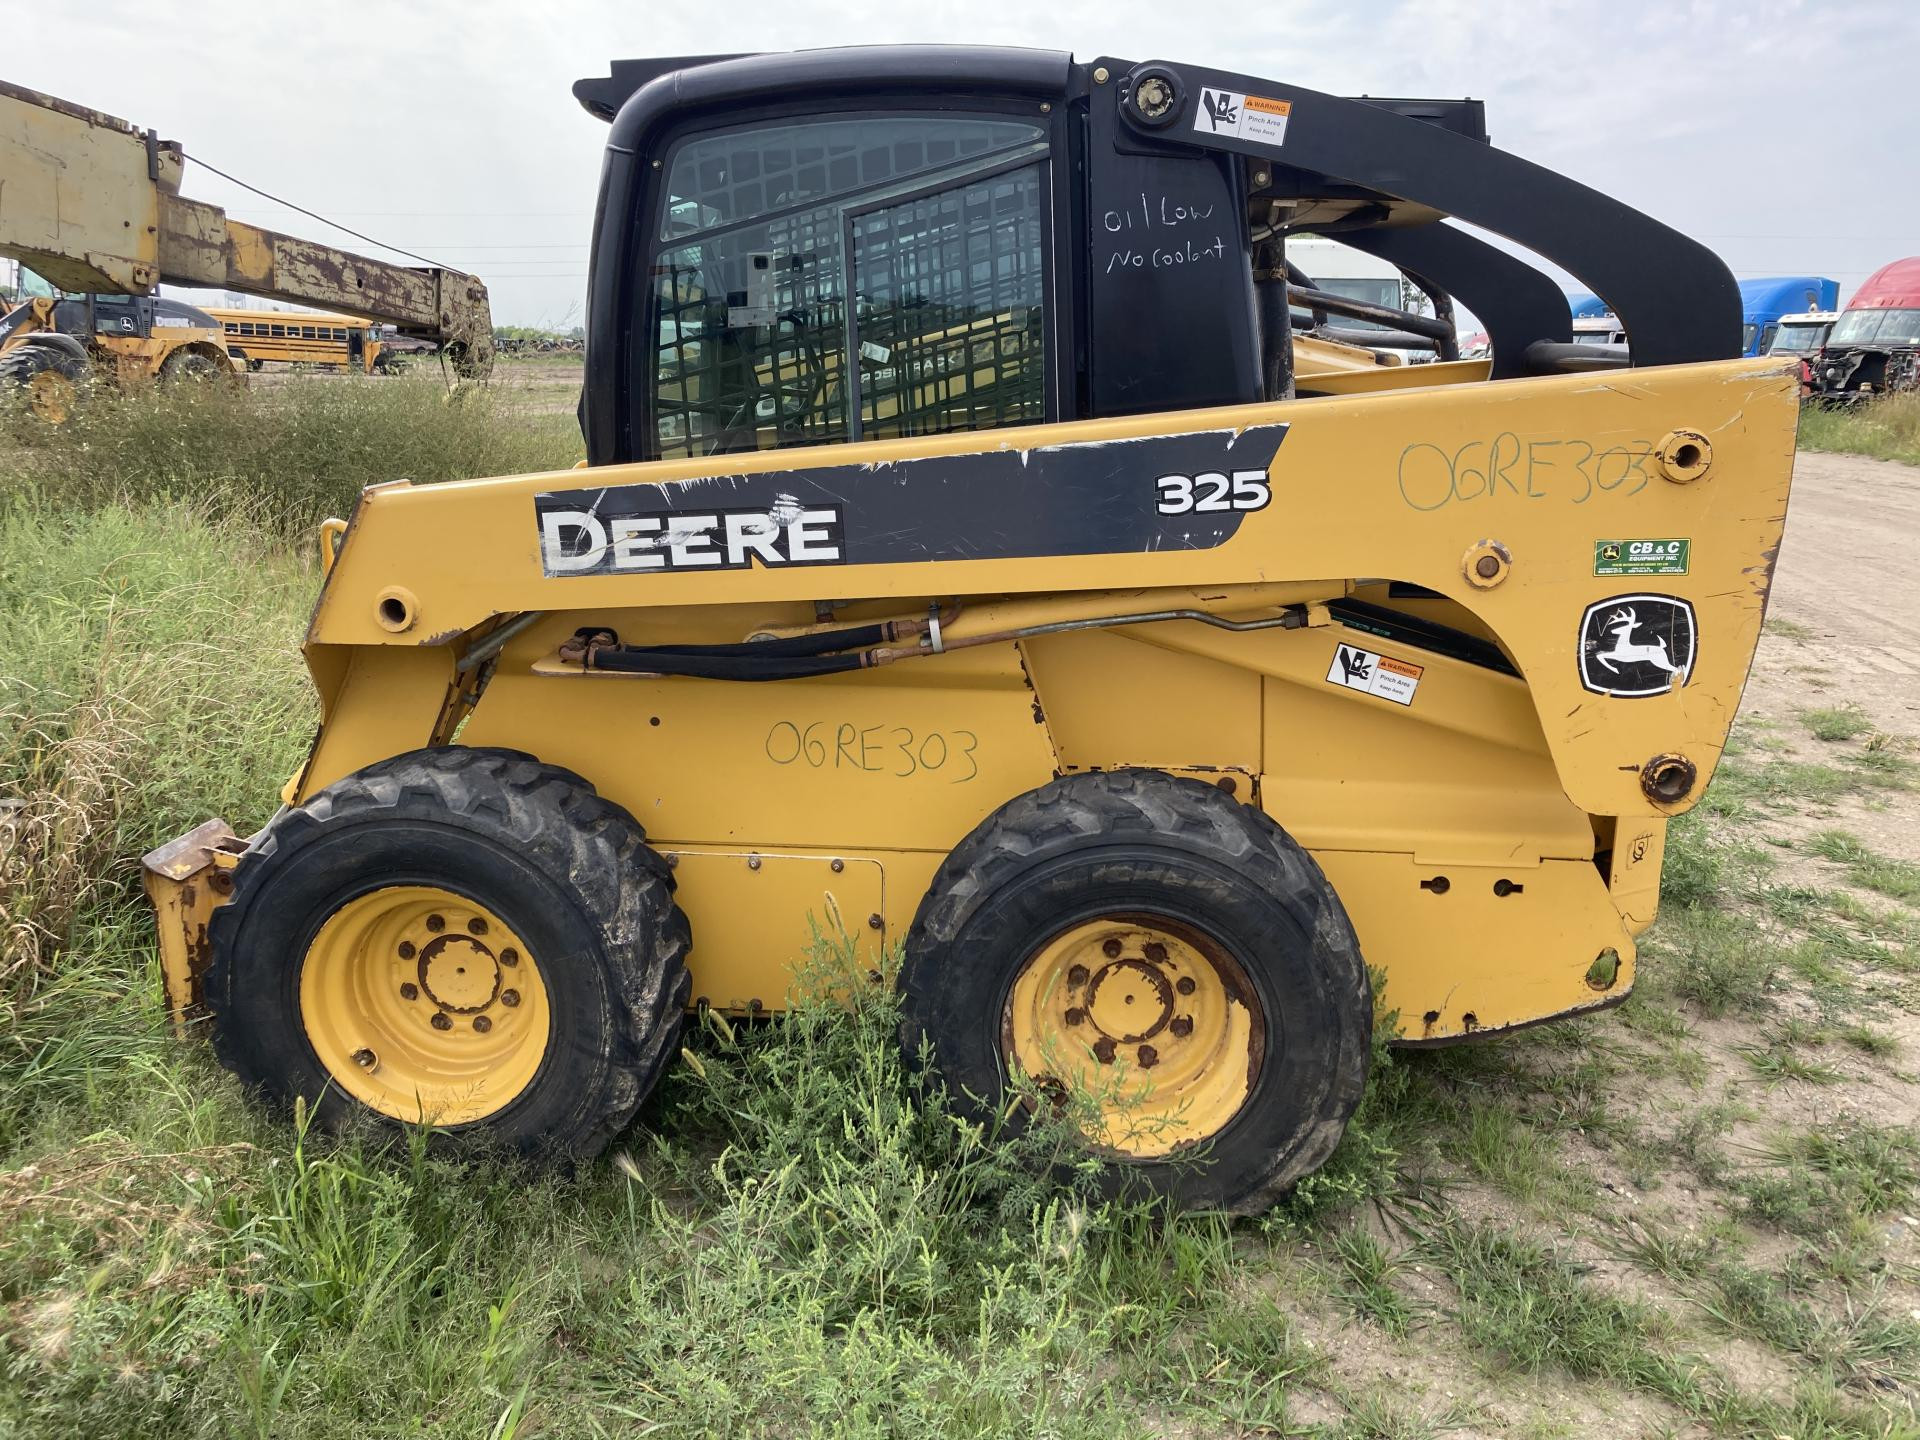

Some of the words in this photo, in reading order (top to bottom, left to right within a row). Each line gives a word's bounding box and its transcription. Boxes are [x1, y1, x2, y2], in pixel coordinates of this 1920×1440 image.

[1254, 101, 1286, 112] WARNING
[1248, 115, 1265, 123] Pinch
[1266, 119, 1281, 127] Area
[1106, 250, 1144, 274] No
[1157, 469, 1269, 514] 325
[541, 509, 840, 572] DEERE
[1629, 542, 1654, 554] CB
[1655, 545, 1664, 553] &
[1668, 542, 1680, 553] C
[1387, 662, 1417, 676] WARNING
[1380, 674, 1396, 684] Pinch
